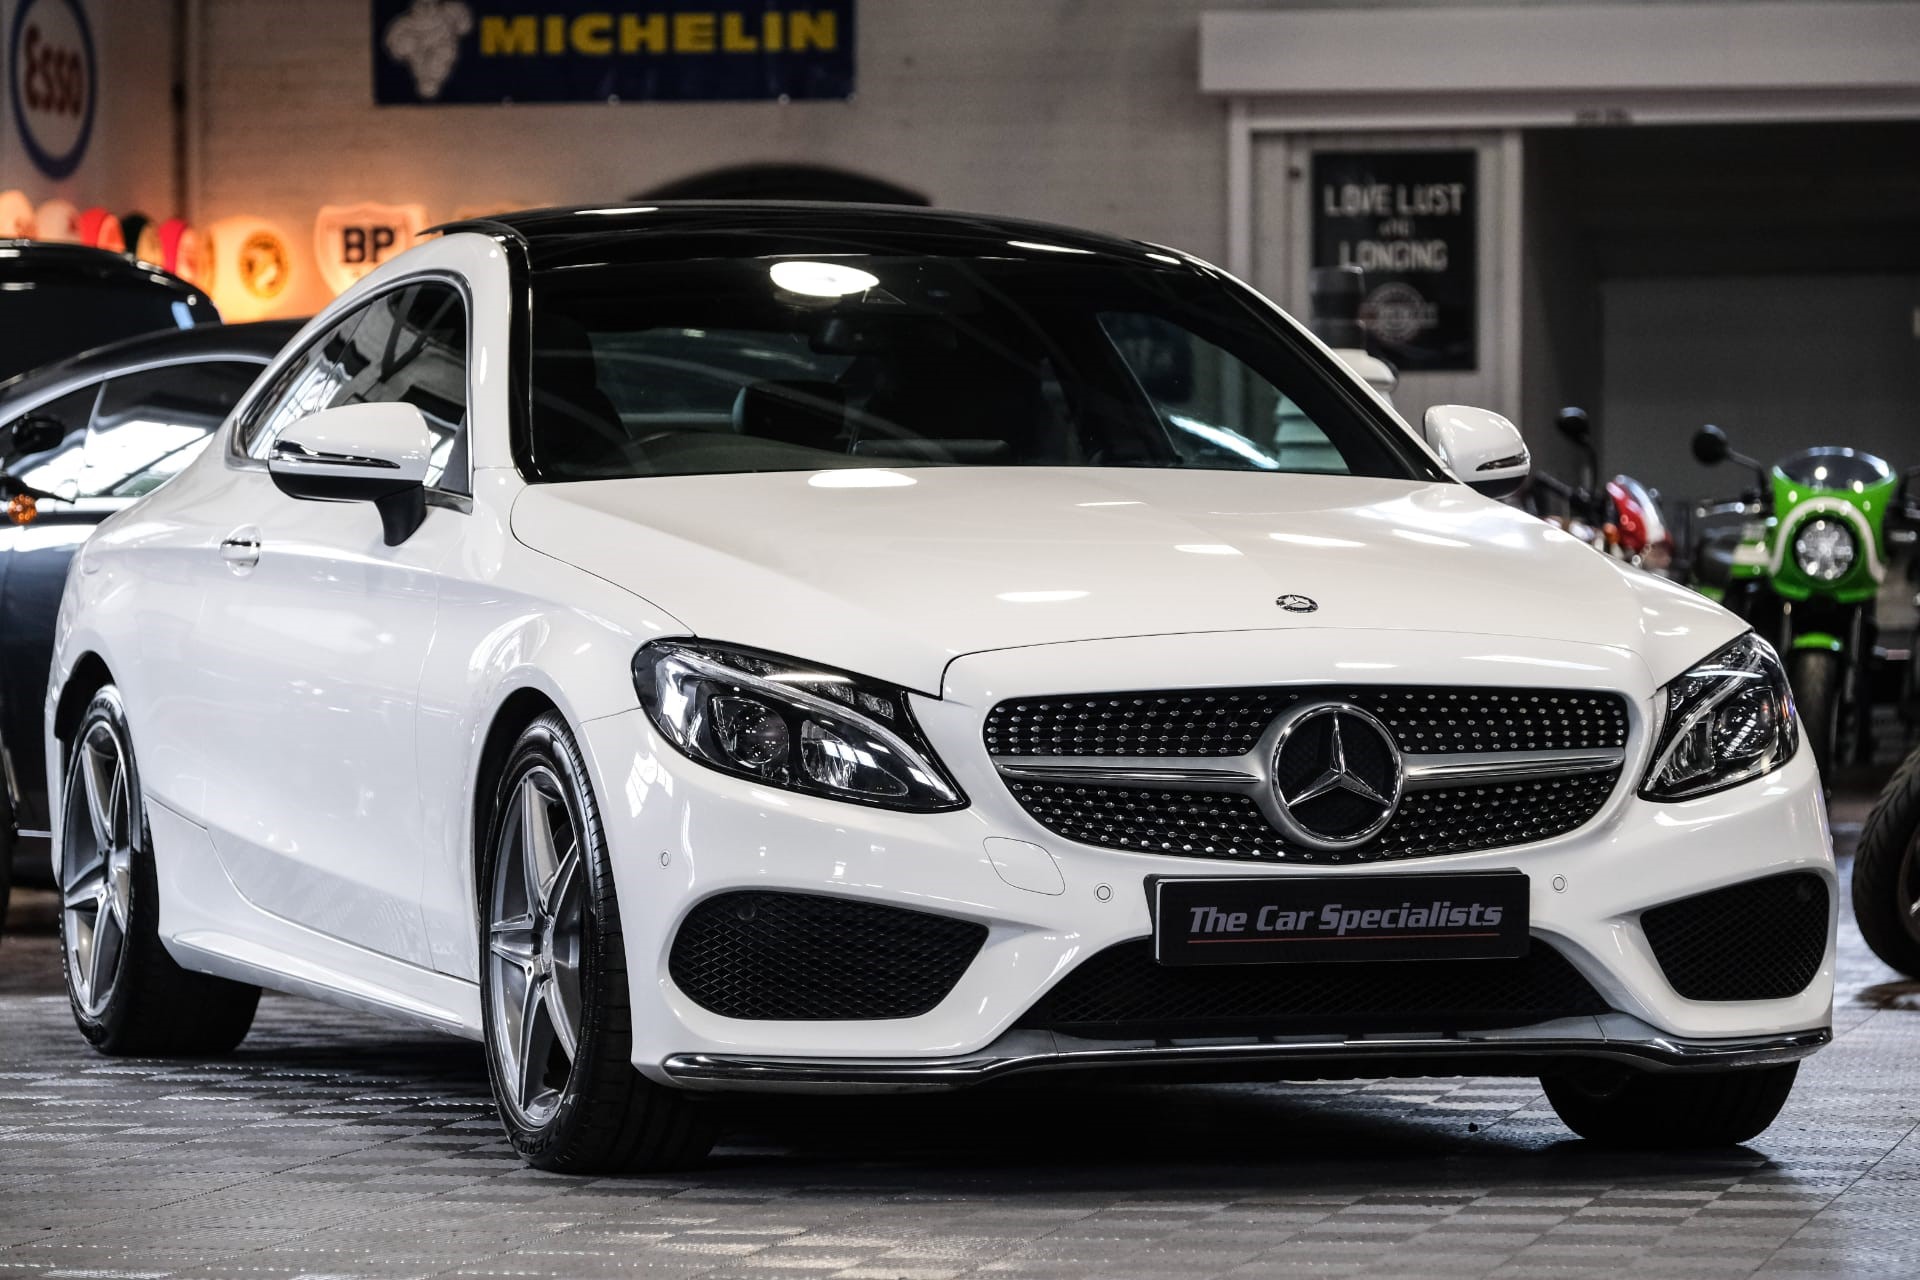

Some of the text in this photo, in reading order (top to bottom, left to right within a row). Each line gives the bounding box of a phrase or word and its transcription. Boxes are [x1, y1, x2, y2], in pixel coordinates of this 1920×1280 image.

[480, 12, 836, 55] MICHELIN
[24, 24, 83, 118] Esso
[1324, 183, 1466, 216] LOVE LUST
[342, 226, 395, 264] BP
[1340, 240, 1448, 271] LONGING
[1189, 901, 1504, 936] The Car Specialists
